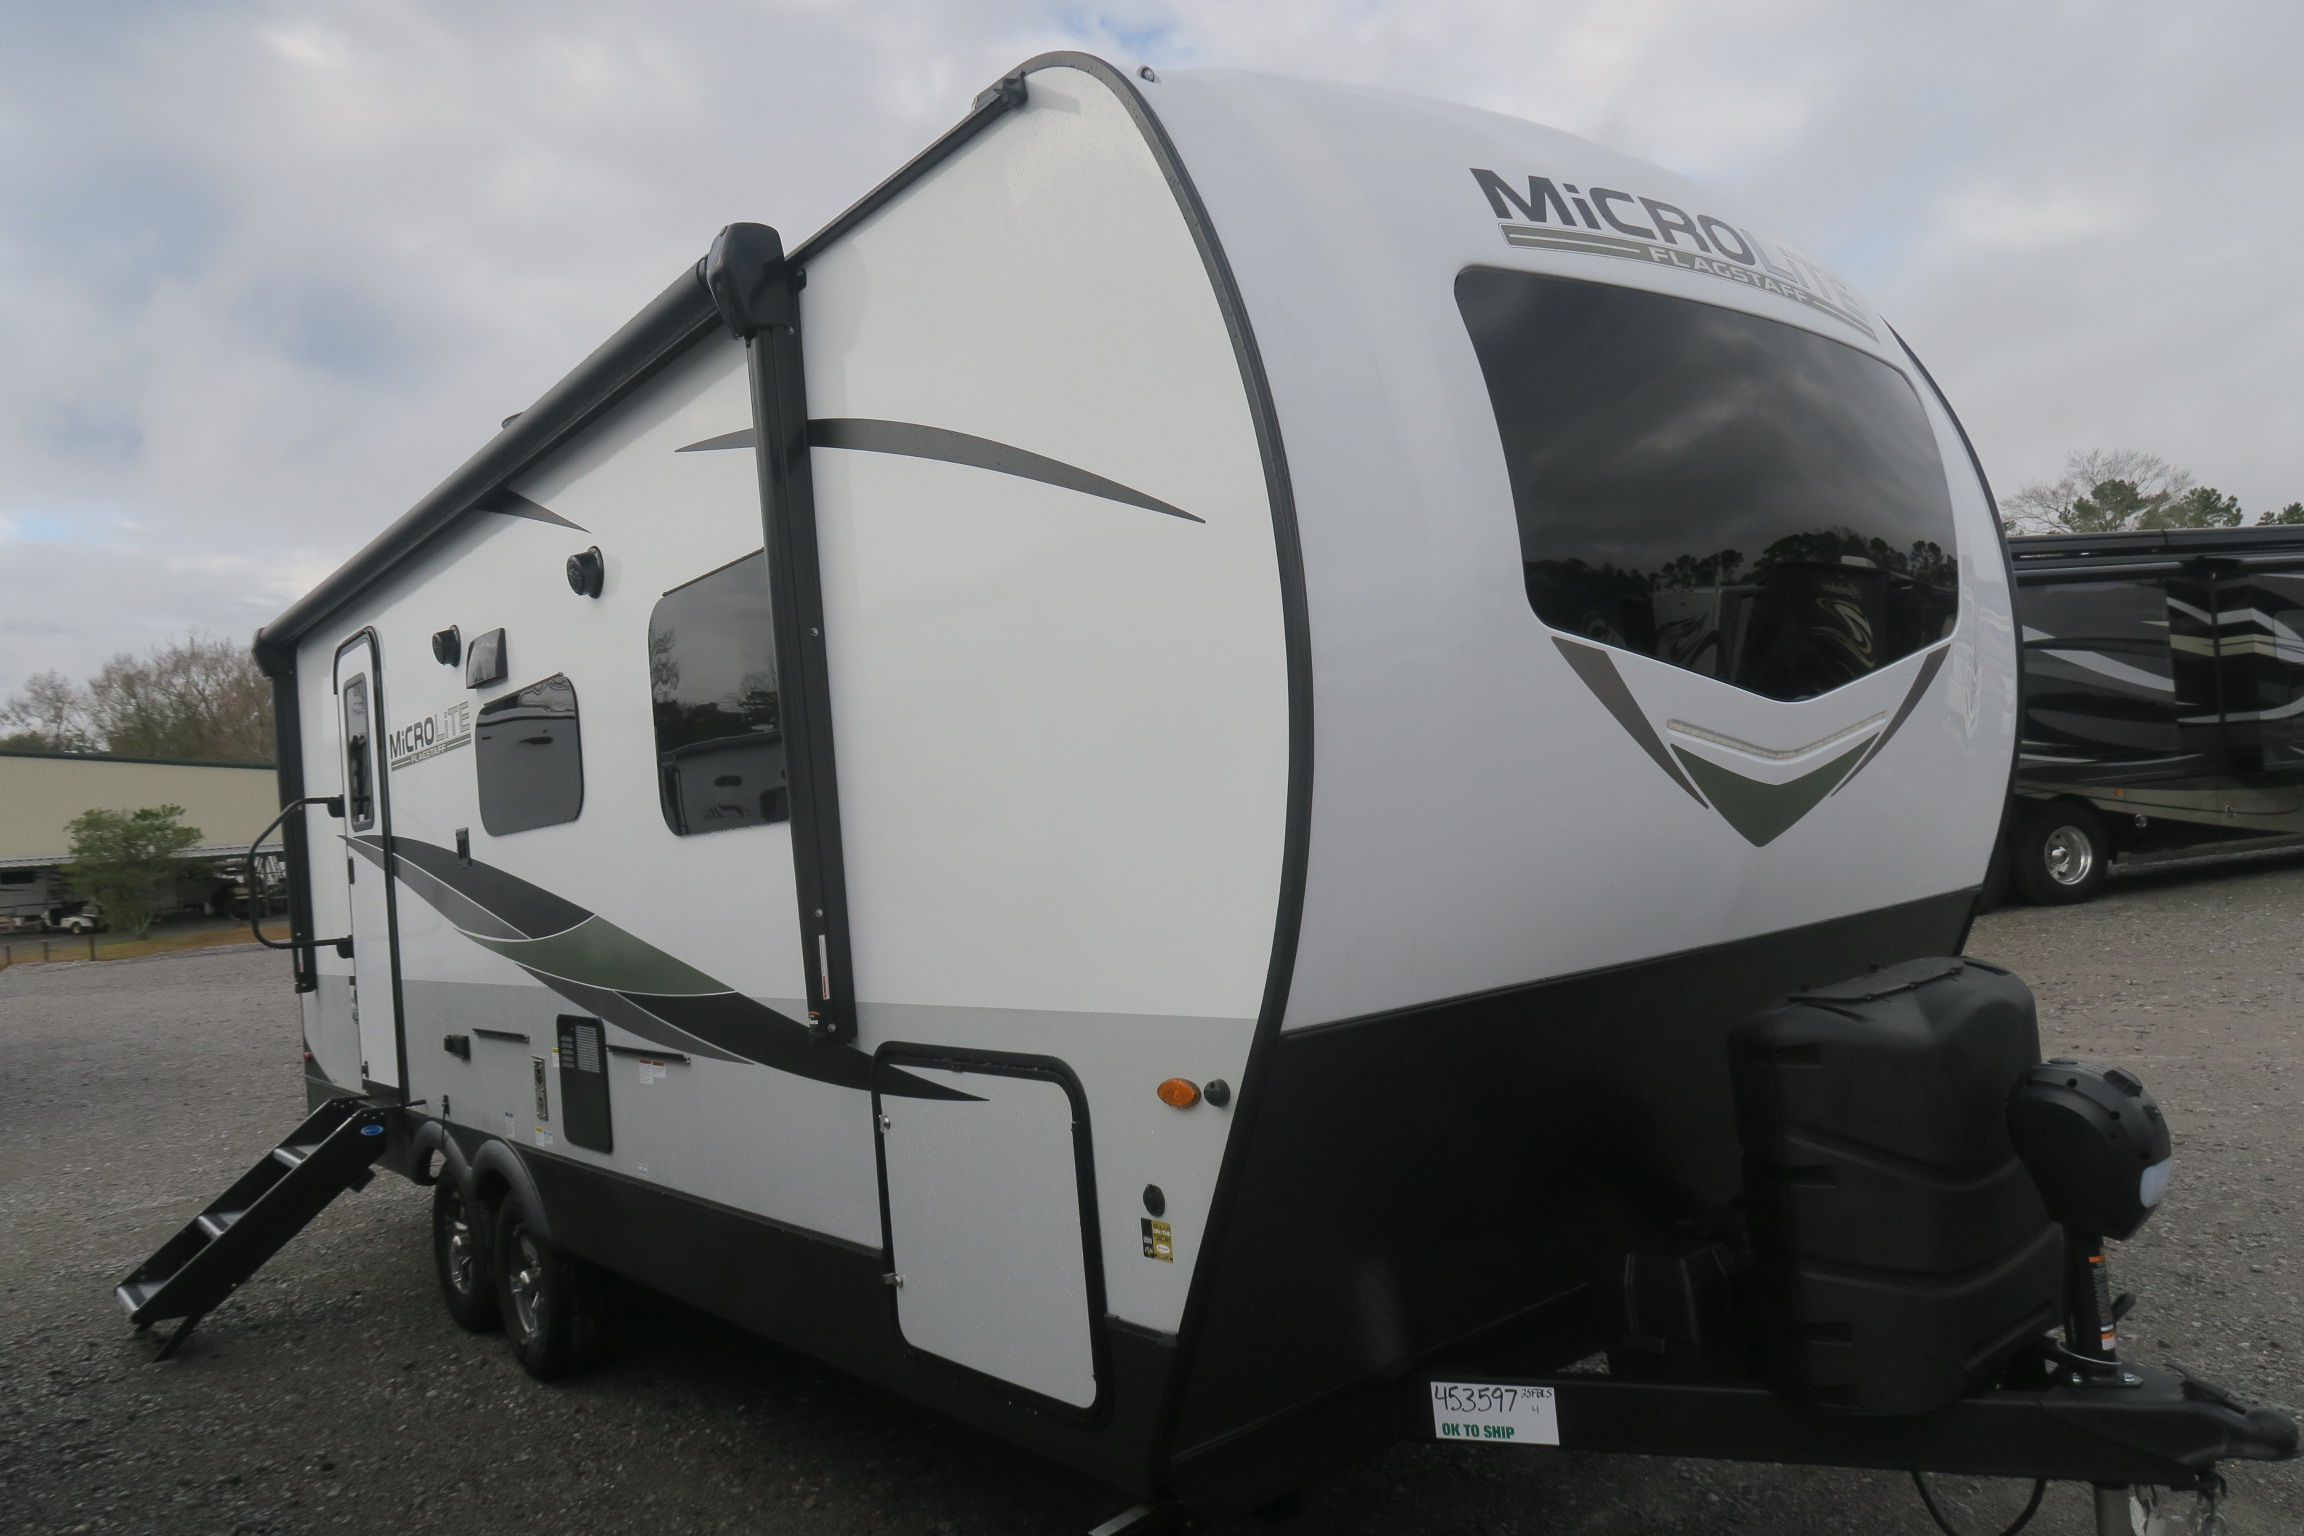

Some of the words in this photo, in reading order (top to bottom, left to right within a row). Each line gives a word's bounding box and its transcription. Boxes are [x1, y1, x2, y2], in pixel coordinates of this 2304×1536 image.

[1647, 246, 1808, 302] FLAGSTAFF
[410, 743, 447, 764] FLAGSTAFF
[1153, 1233, 1172, 1243] SIDE
[1434, 1384, 1518, 1413] 453597
[1531, 1404, 1540, 1415] 4
[1442, 1422, 1461, 1437] OK
[1463, 1423, 1480, 1438] TO
[1483, 1424, 1516, 1440] SHIP
